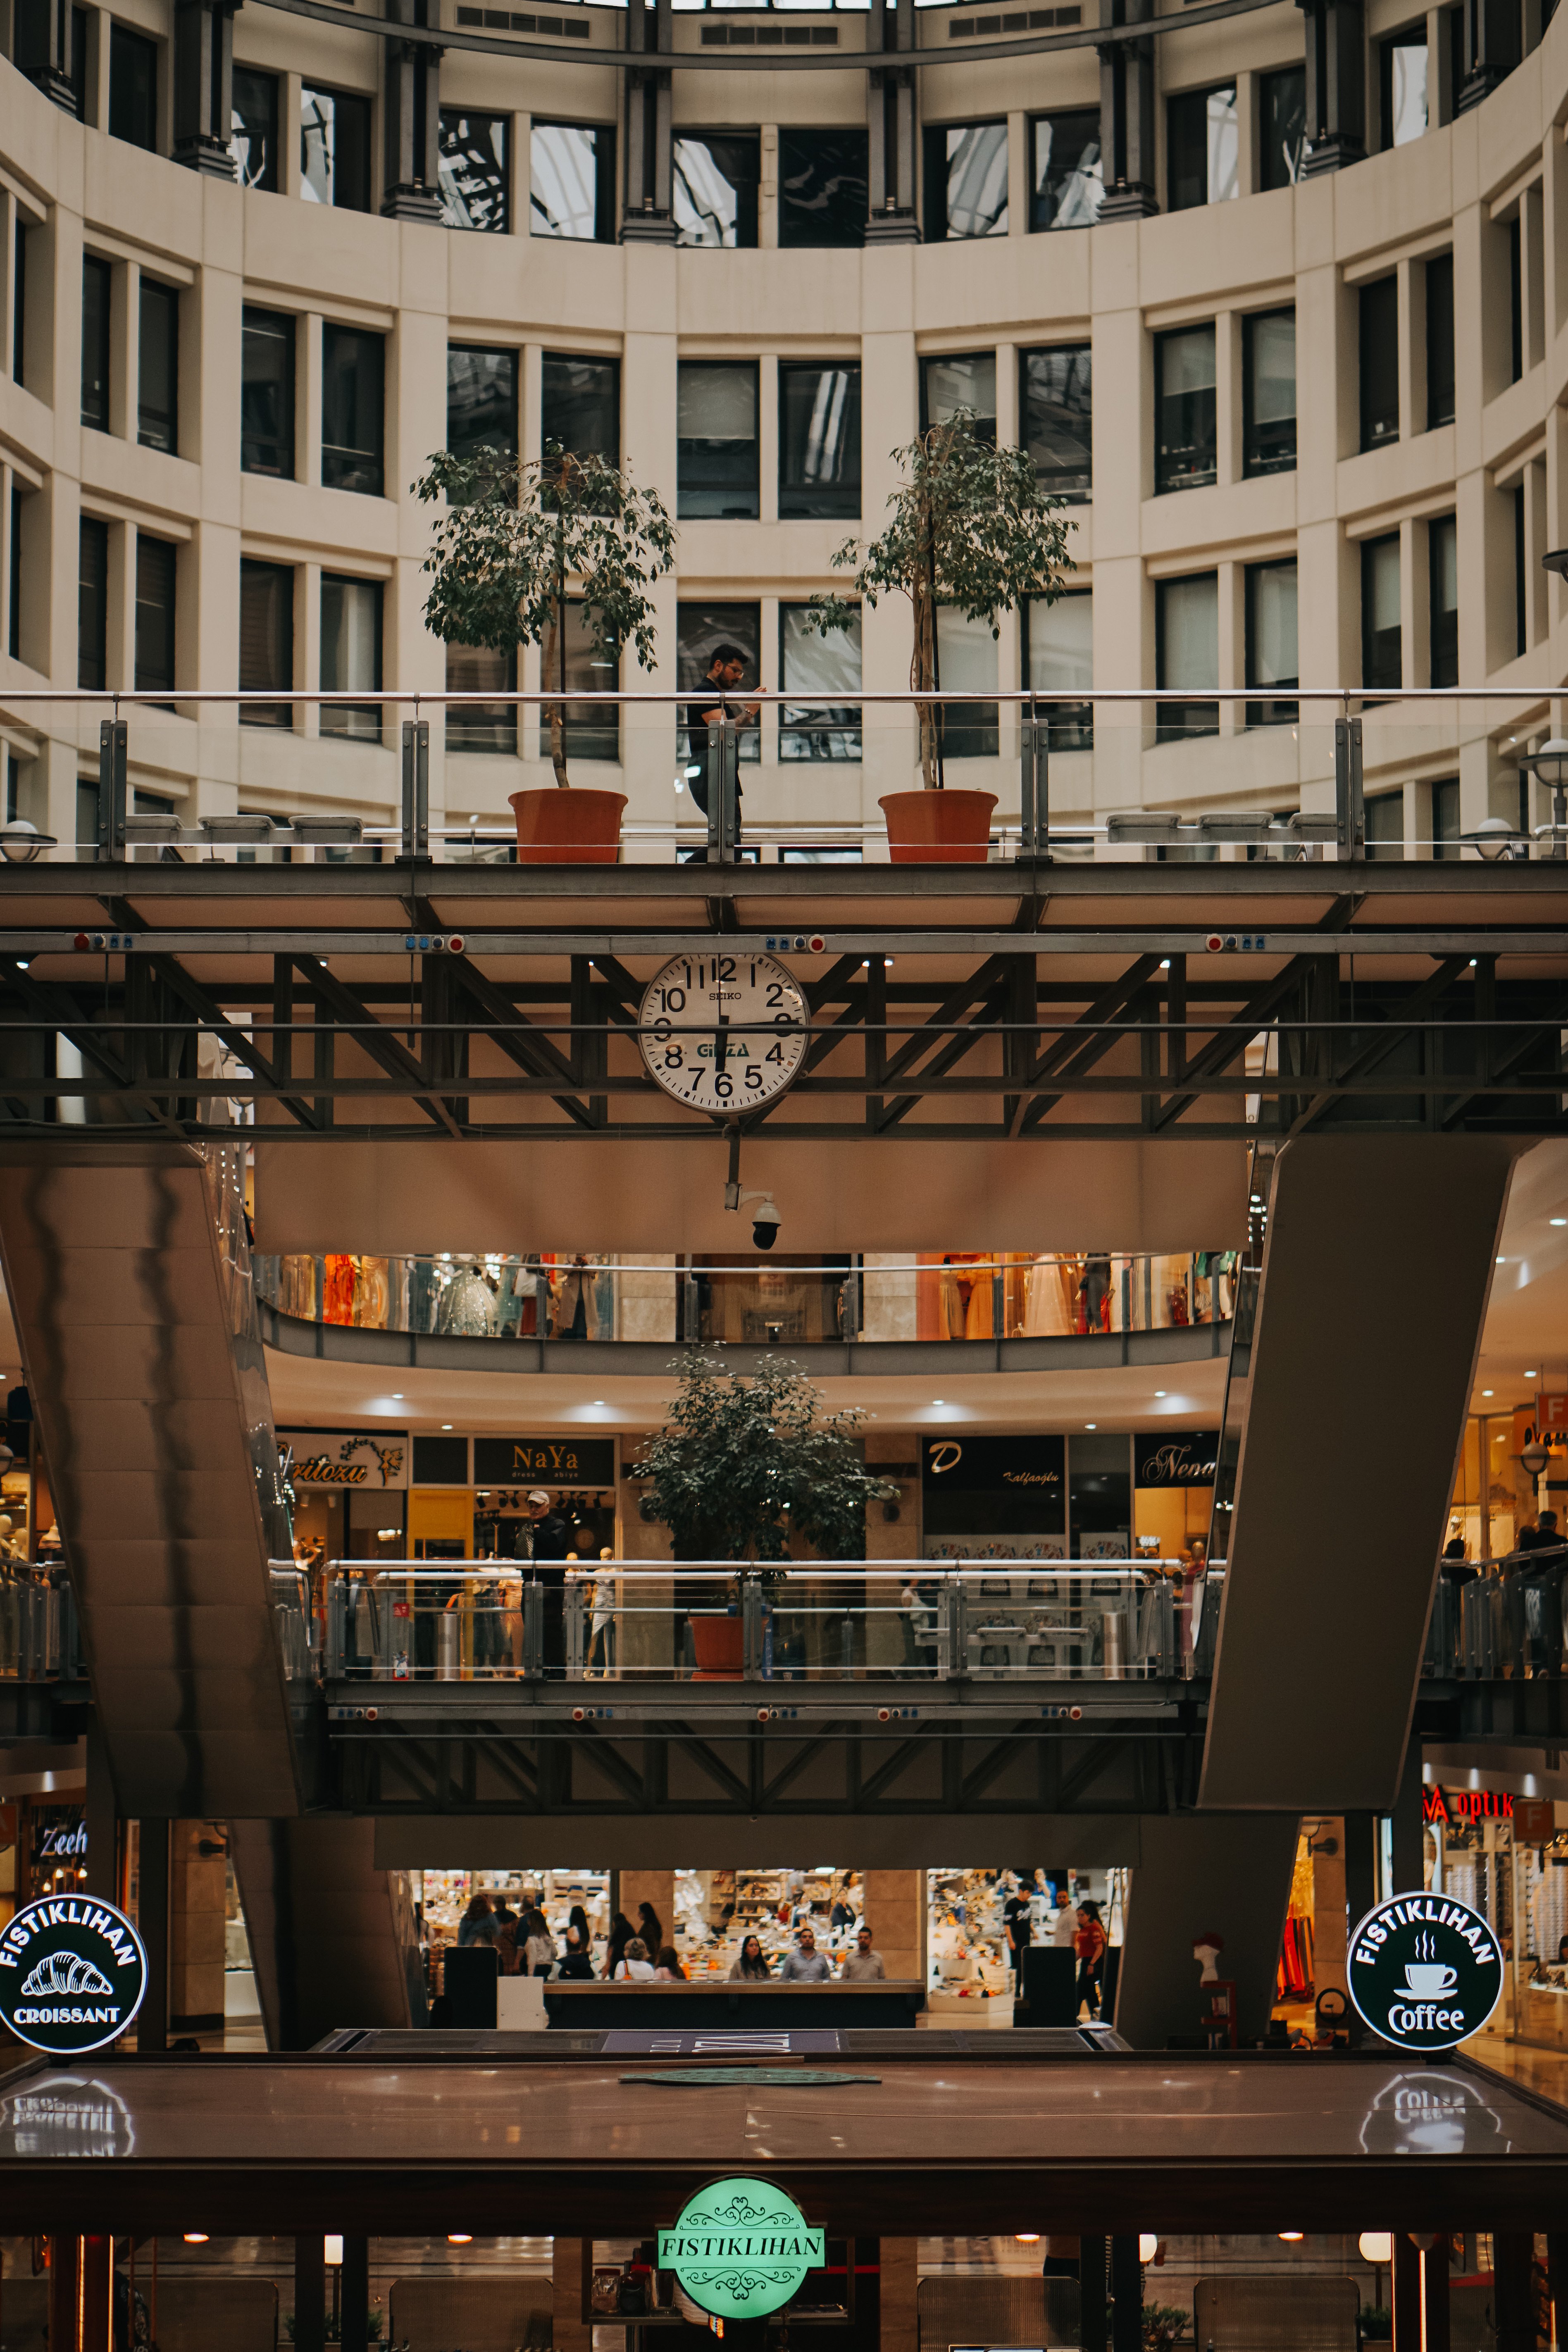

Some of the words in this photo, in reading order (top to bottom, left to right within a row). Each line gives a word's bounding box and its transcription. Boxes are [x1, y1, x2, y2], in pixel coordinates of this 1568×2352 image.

[686, 965, 704, 989] 11
[712, 958, 736, 982] 12
[751, 964, 755, 987] 1
[662, 988, 686, 1012] 10
[766, 983, 784, 1007] 2
[665, 1044, 683, 1069] 8
[765, 1042, 784, 1066] 4
[688, 1068, 705, 1091] 7
[715, 1073, 733, 1098] 6
[744, 1065, 763, 1089] 5
[512, 1445, 579, 1469] NaYa
[0, 1902, 137, 1967] FISTIKLIHAN
[1356, 1899, 1495, 1966] FISTIKLIHAN
[14, 2008, 120, 2024] CROISSANT
[1388, 2004, 1464, 2035] Coffee
[660, 2236, 822, 2257] FISTIKLIHAN
